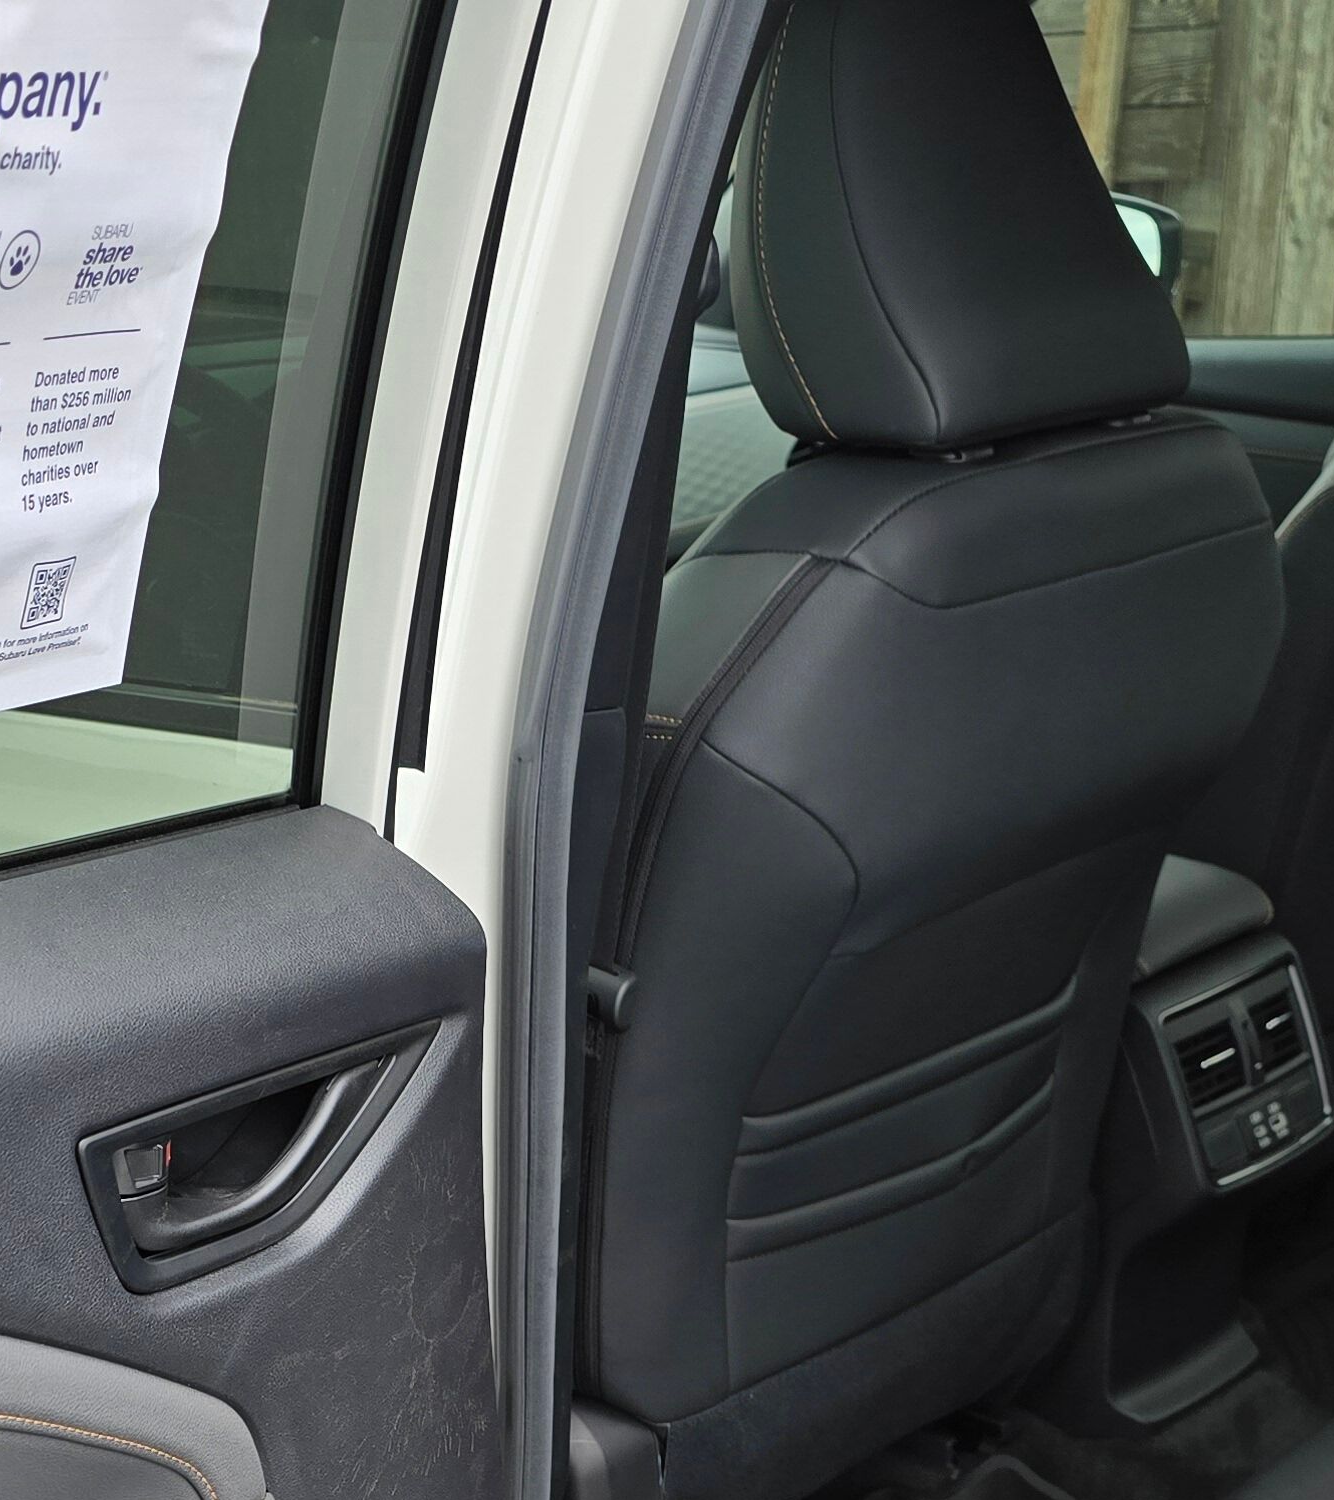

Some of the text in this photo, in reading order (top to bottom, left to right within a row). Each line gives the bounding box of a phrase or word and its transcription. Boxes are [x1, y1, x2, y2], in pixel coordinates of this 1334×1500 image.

[0, 146, 63, 177] charity.
[92, 223, 134, 240] SUBARU
[83, 242, 133, 265] share
[74, 264, 139, 289] the love
[67, 288, 100, 305] EVENT
[34, 364, 120, 390] Donated more
[30, 385, 132, 413] than $256 million
[26, 410, 116, 438] to national and
[22, 436, 84, 462] hometown
[21, 459, 99, 487] charities over
[21, 488, 74, 512] 15 years.
[3, 639, 15, 648] for
[17, 636, 37, 646] more
[80, 623, 89, 632] on
